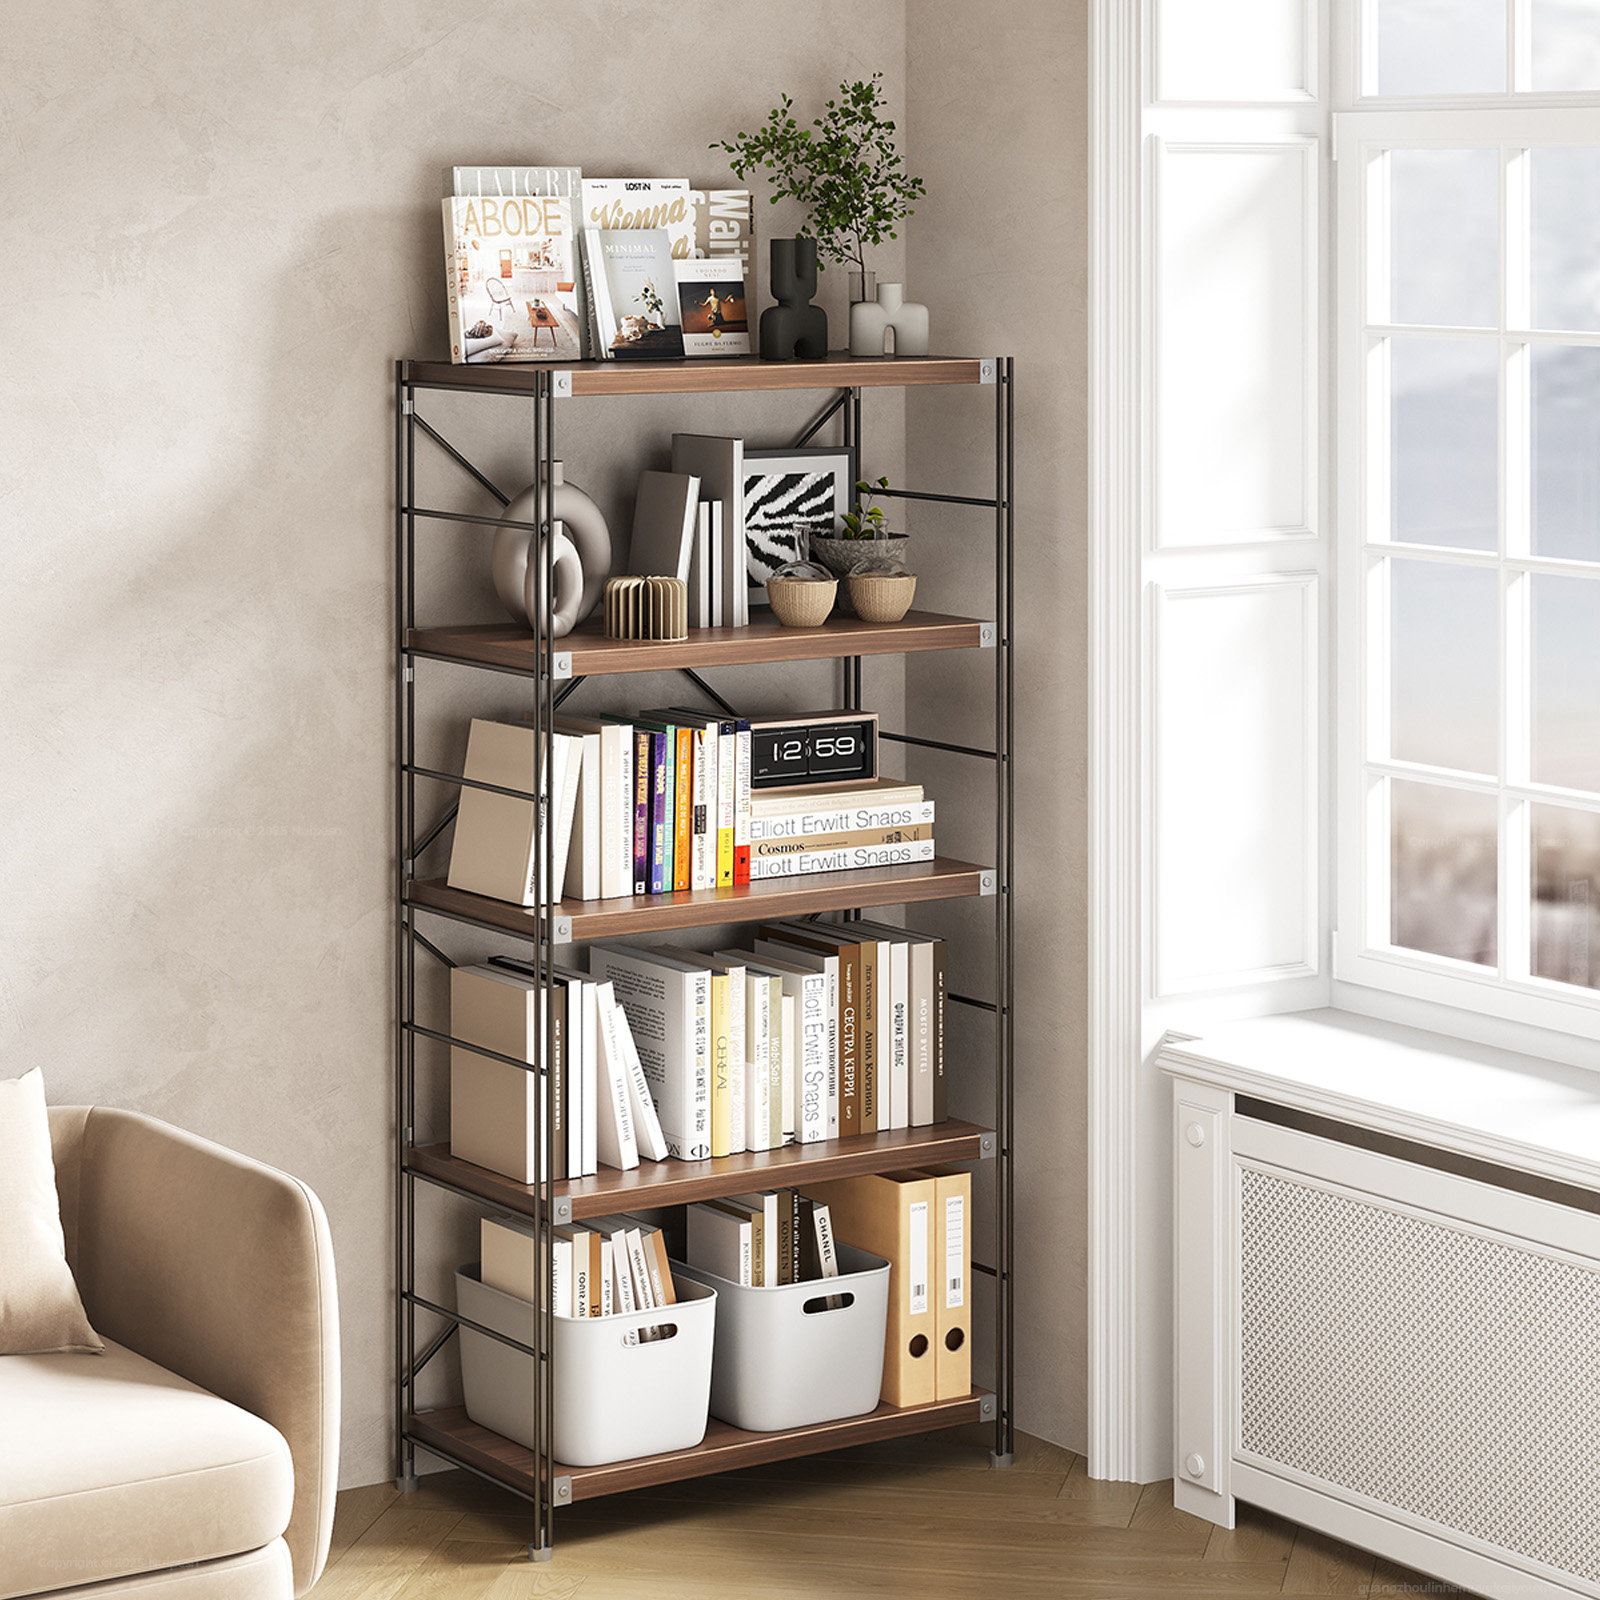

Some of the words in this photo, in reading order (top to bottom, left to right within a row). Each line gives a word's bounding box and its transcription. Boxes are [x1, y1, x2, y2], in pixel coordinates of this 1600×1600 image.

[464, 198, 562, 237] ABODE
[590, 196, 687, 229] Vienna
[605, 244, 657, 254] MINIMAL
[773, 740, 801, 761] 12
[815, 737, 855, 757] 59
[750, 819, 796, 839] Elliott
[802, 813, 850, 834] Erwitt
[856, 809, 912, 829] Snaps
[758, 842, 805, 856] Cosmos
[800, 852, 848, 872] Erwitt
[854, 848, 911, 866] Snaps
[804, 978, 824, 1019] Elliott
[804, 1023, 824, 1067] Erwitt
[844, 1007, 855, 1055] СЕСТРА
[865, 1030, 873, 1060] АННА
[716, 1035, 728, 1097] CEREAL
[844, 1058, 855, 1097] КЕРРИ
[804, 1070, 824, 1123] Snaps
[865, 1062, 873, 1118] КАРЕНИНА
[781, 1220, 789, 1270] KONSTEN
[819, 1216, 832, 1263] CHANEL
